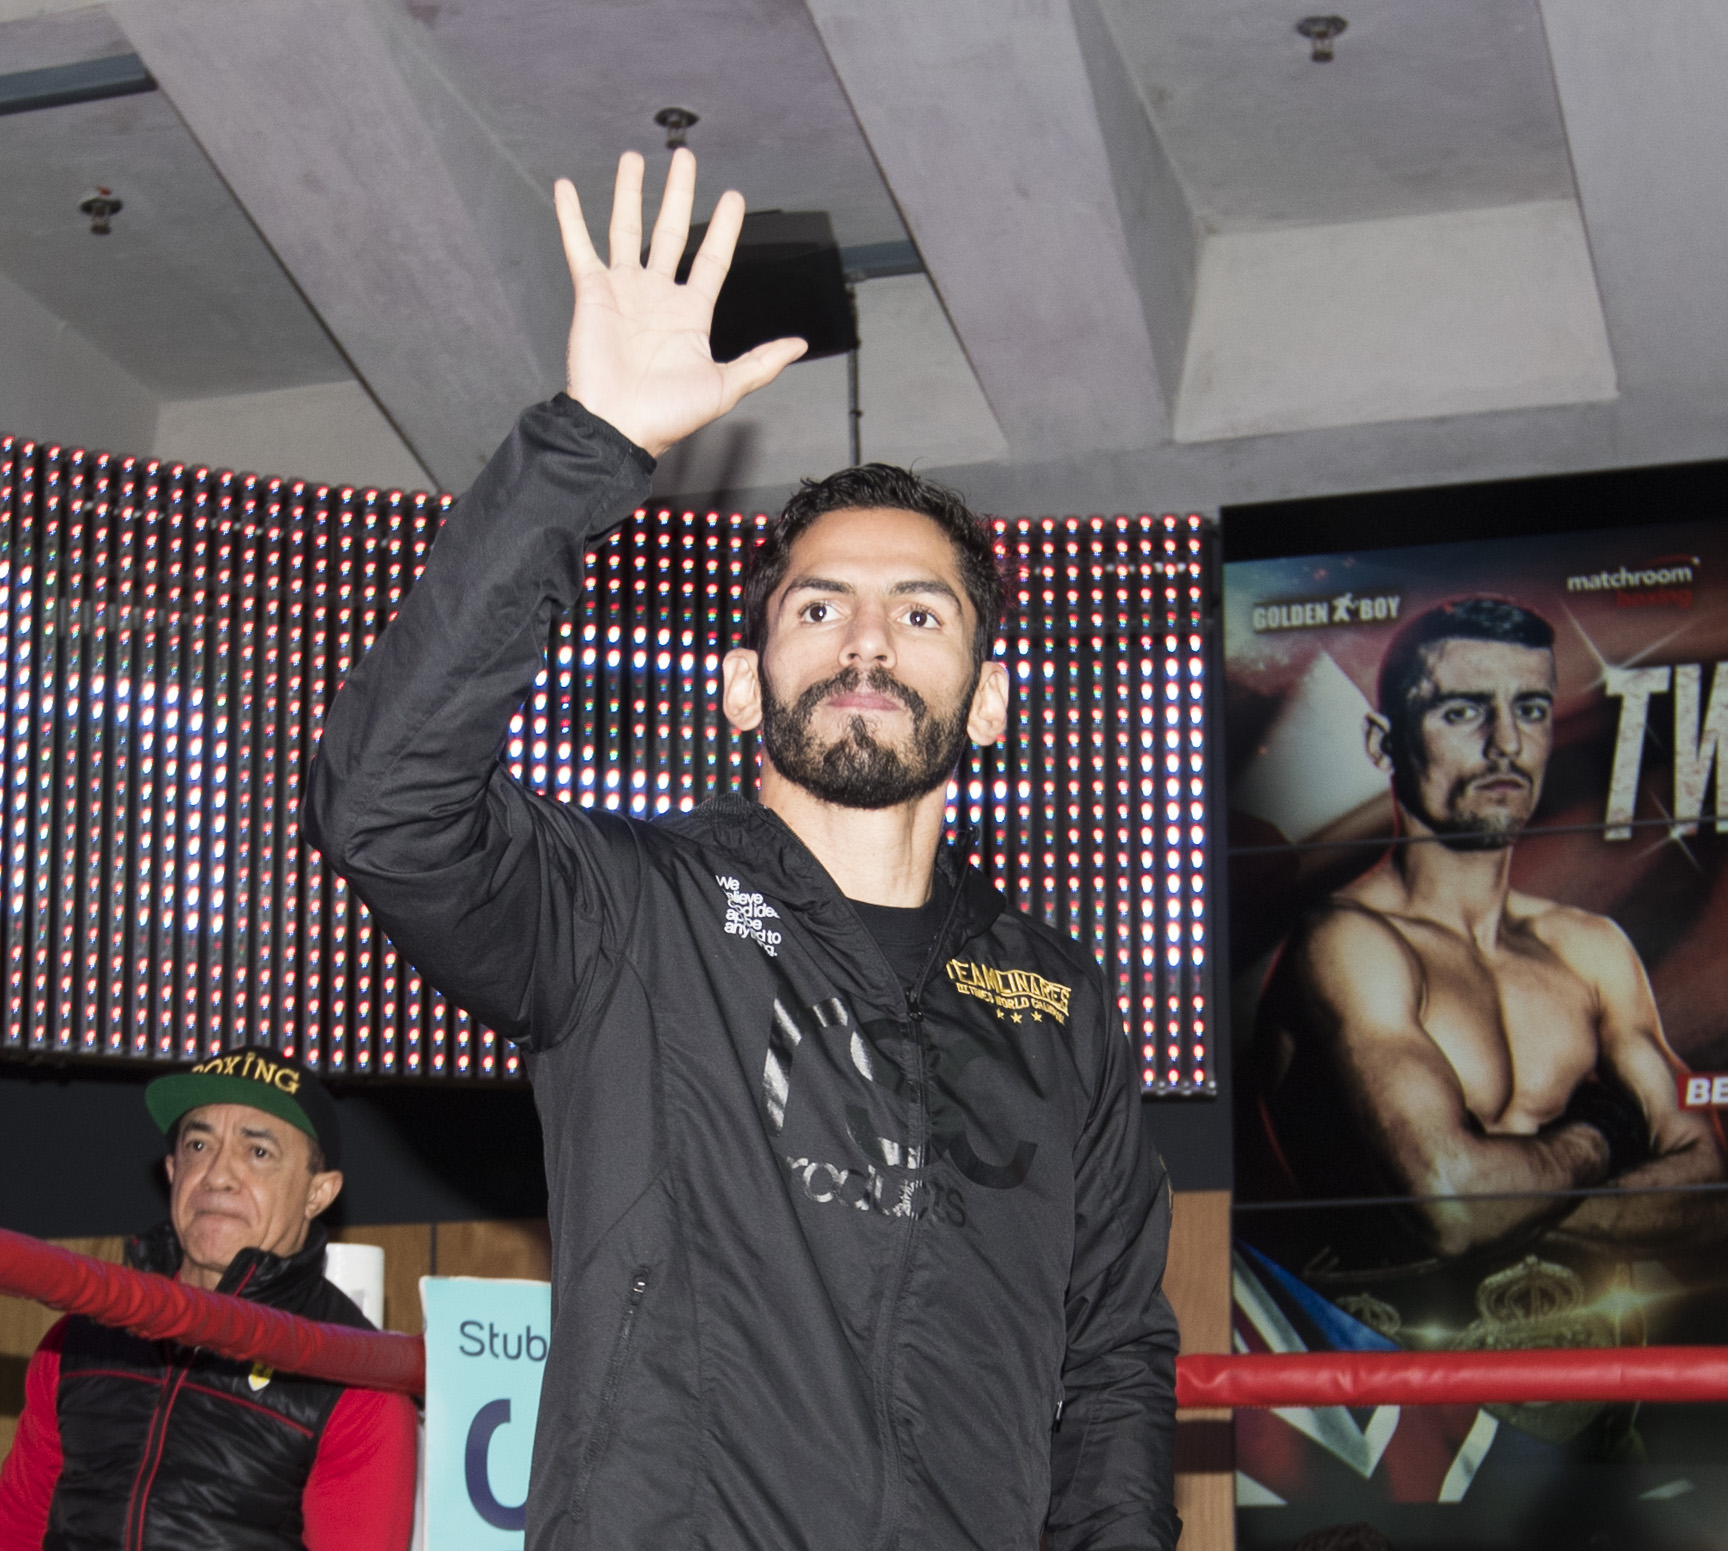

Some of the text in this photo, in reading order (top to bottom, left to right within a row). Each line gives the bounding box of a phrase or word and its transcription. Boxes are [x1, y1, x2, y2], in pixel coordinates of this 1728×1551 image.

[1567, 565, 1693, 591] matchroom
[1253, 595, 1401, 629] GOLDEN BOY
[715, 874, 740, 891] We
[995, 995, 1029, 1010] WORLD
[459, 1320, 548, 1362] Stub
